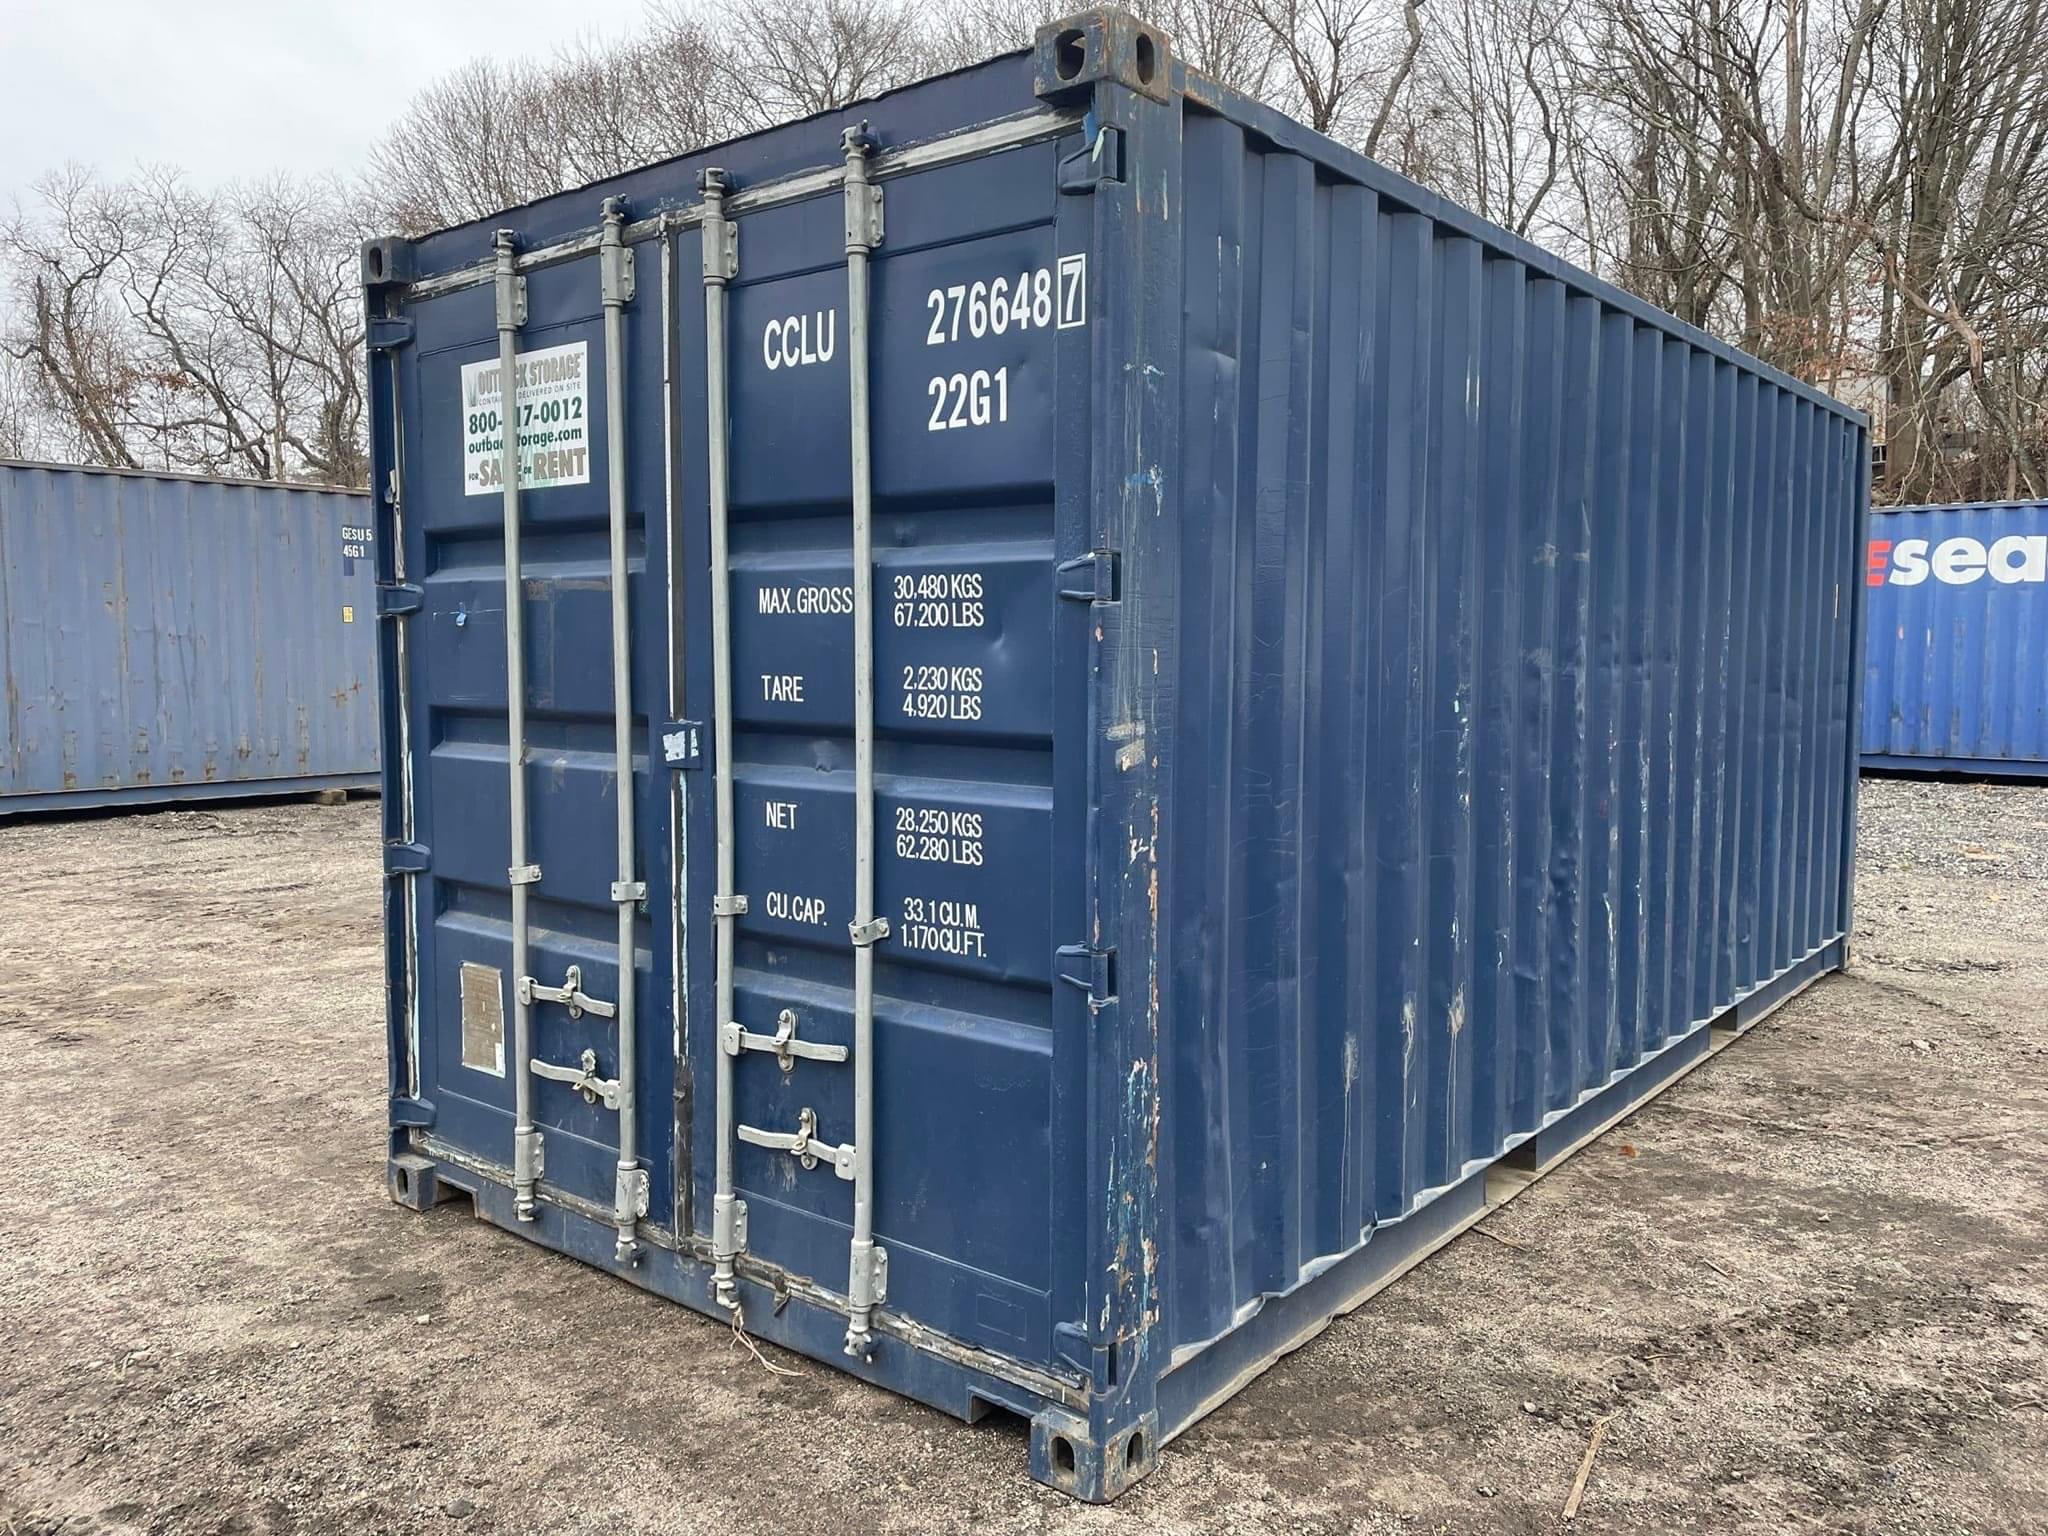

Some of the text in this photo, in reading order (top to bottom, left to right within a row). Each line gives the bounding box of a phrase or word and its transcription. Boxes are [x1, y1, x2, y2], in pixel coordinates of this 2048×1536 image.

[763, 309, 835, 370] CCLU
[478, 352, 581, 394] OUTCK STORAGE
[517, 387, 552, 399] DELIVERED
[554, 384, 563, 393] ON
[566, 381, 581, 391] SITE
[469, 396, 582, 434] 800-17-0012
[928, 366, 1007, 431] 22G1
[468, 428, 582, 454] outbactorage.com
[468, 472, 479, 480] FOR
[479, 456, 522, 487] SAE
[534, 447, 587, 480] RENT
[342, 527, 365, 541] GESU
[343, 544, 365, 557] 45G1
[1866, 535, 2048, 587] Esea
[759, 573, 983, 614] MAX.GROSS 30,480 KGS
[894, 602, 984, 627] 67,200 LBS
[761, 666, 983, 702] TARE 2,230 KGS
[902, 694, 982, 720] 4,920 LBS
[766, 801, 983, 838] NET 28,250 KGS
[896, 834, 983, 866] 62,280 LBS
[766, 892, 828, 926] CU.CAP.
[904, 897, 936, 924] 33.1
